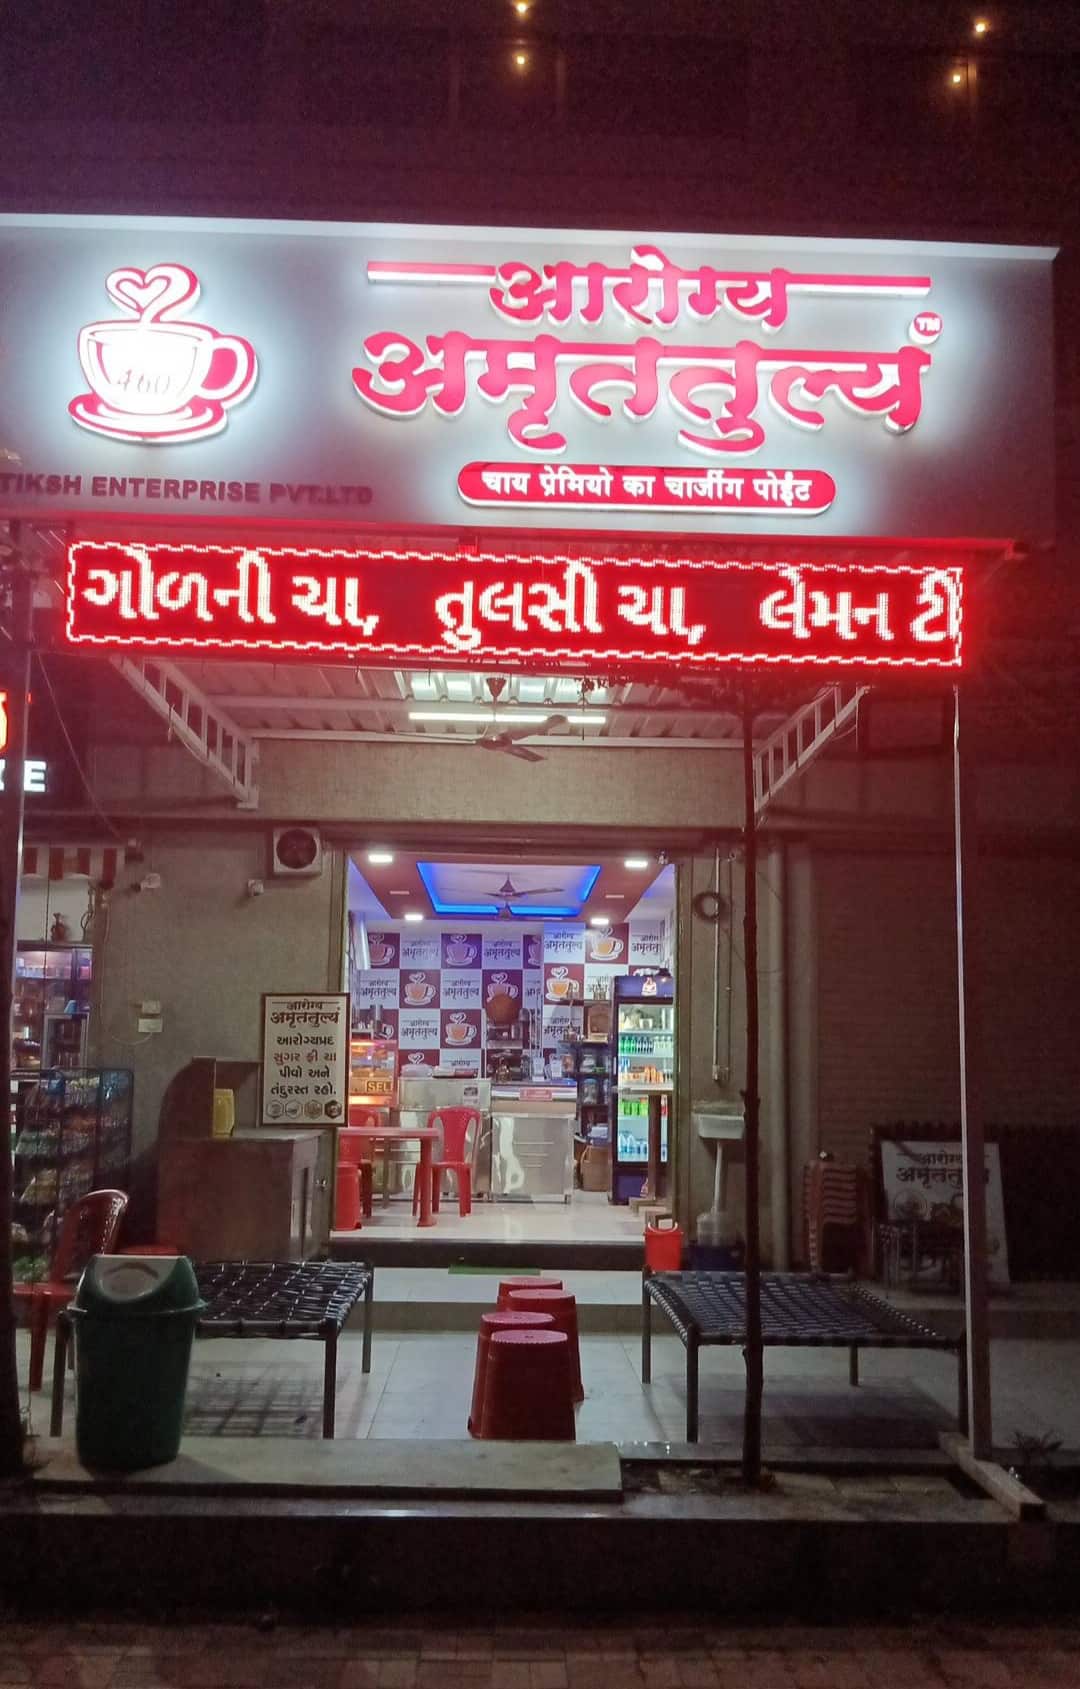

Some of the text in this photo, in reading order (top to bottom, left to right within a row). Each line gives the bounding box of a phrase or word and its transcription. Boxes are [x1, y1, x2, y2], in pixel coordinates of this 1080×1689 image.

[490, 245, 792, 329] आरोग्य
[352, 331, 931, 455] अमृततुल्य
[91, 476, 260, 502] ENTERPRISE
[481, 471, 531, 495] चाय
[622, 475, 657, 498] का
[82, 546, 277, 624] ગોળની
[435, 561, 602, 649] તુલસી
[759, 565, 894, 641] લેમન
[909, 570, 959, 642] ટી
[308, 1065, 330, 1079] અને
